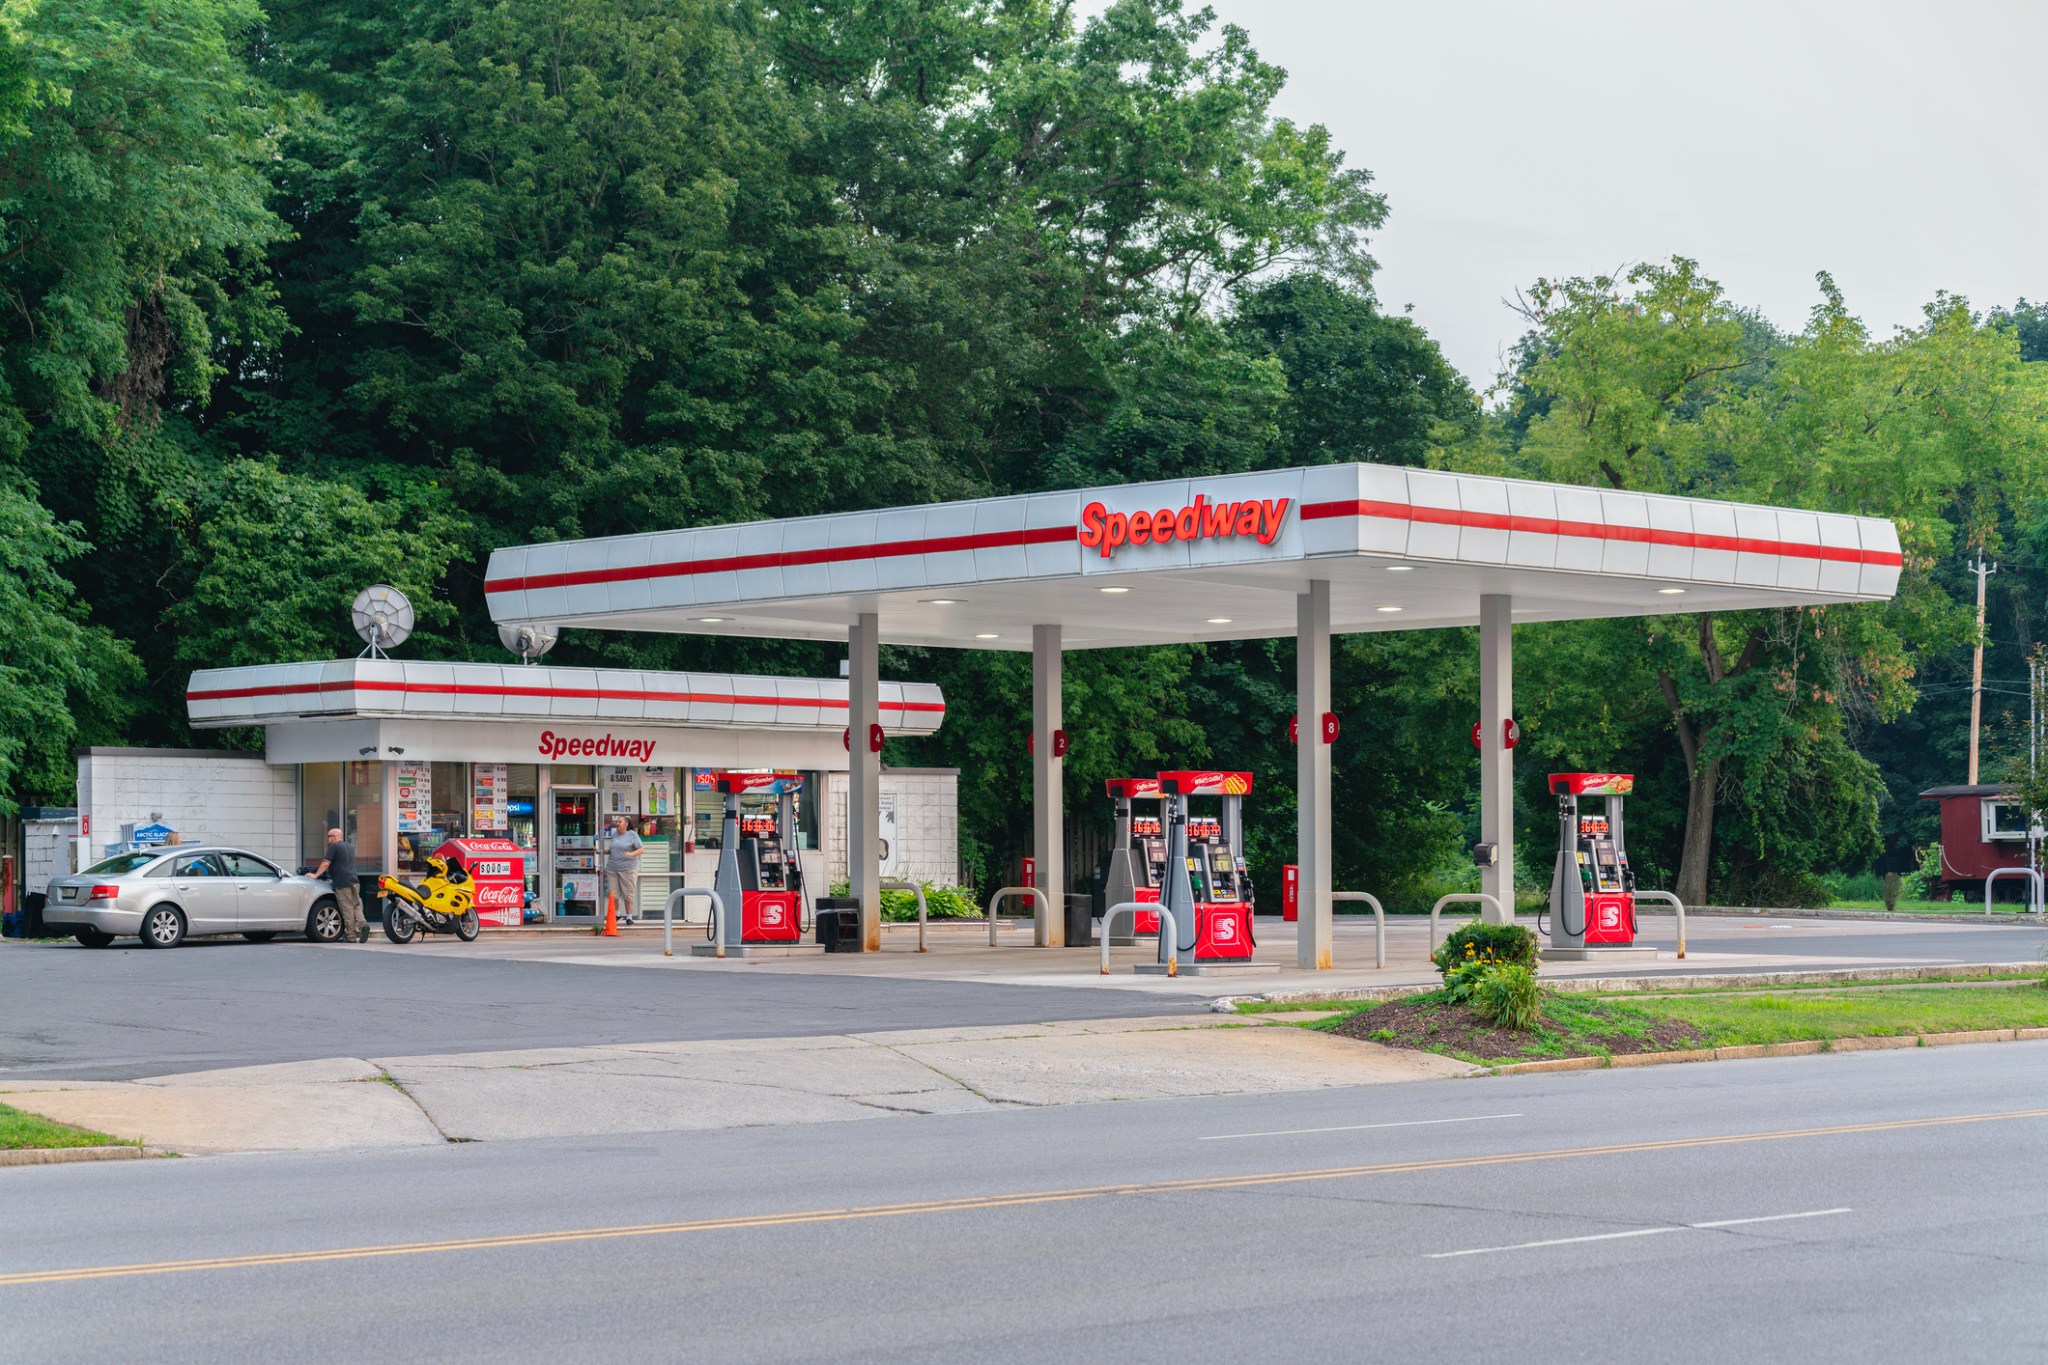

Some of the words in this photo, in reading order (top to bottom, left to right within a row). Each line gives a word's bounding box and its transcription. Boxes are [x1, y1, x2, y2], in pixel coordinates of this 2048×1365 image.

[1079, 494, 1290, 558] Speedway
[1328, 722, 1335, 734] 8
[875, 732, 881, 743] 4
[1059, 738, 1065, 748] 2
[538, 730, 656, 763] Speedway
[615, 774, 633, 783] SAVE!
[470, 842, 513, 851] Coca-Cola
[479, 886, 520, 904] Coca-Cola
